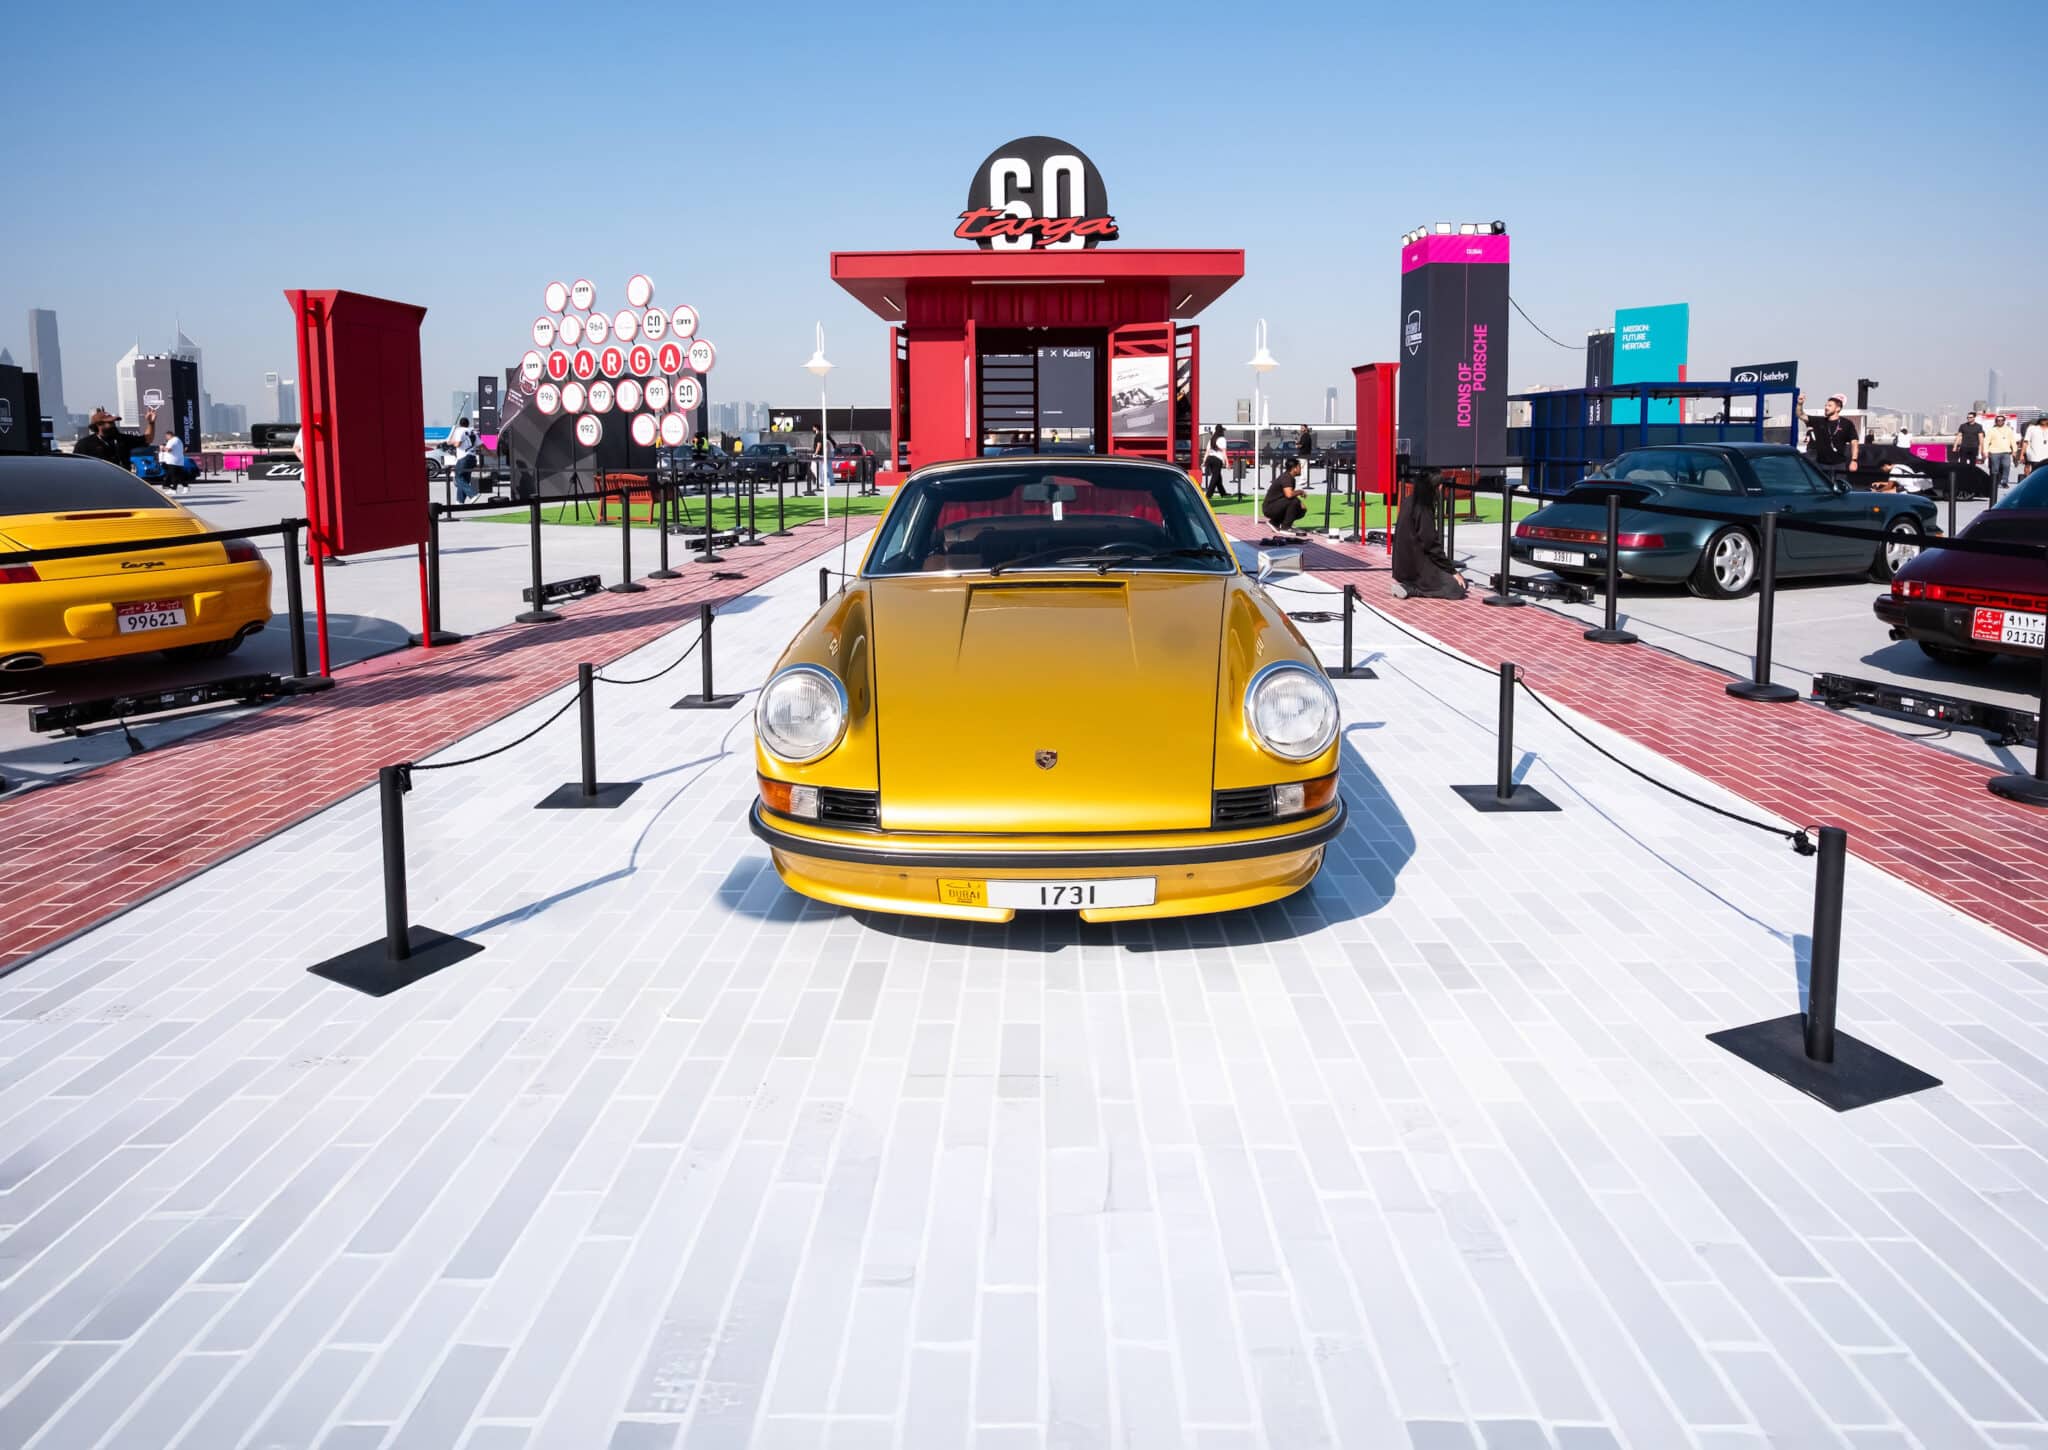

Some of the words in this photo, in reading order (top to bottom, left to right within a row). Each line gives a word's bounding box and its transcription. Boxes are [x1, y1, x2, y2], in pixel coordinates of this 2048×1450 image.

[990, 155, 1086, 250] 60
[954, 207, 1119, 246] targa
[1622, 333, 1646, 342] FUTURE
[1622, 341, 1652, 351] HERITAGE
[692, 349, 708, 359] 993
[1063, 349, 1092, 360] Kasing
[1472, 323, 1488, 392] PORSCHE
[1458, 362, 1472, 382] OF
[1763, 370, 1789, 382] Sotheby's
[592, 390, 607, 398] 997
[649, 387, 664, 396] 991
[1457, 383, 1472, 428] ICONS
[580, 424, 594, 433] 992
[144, 602, 159, 613] 22
[127, 612, 179, 630] 99621
[2006, 630, 2045, 646] 91130
[1040, 885, 1096, 905] 1731
